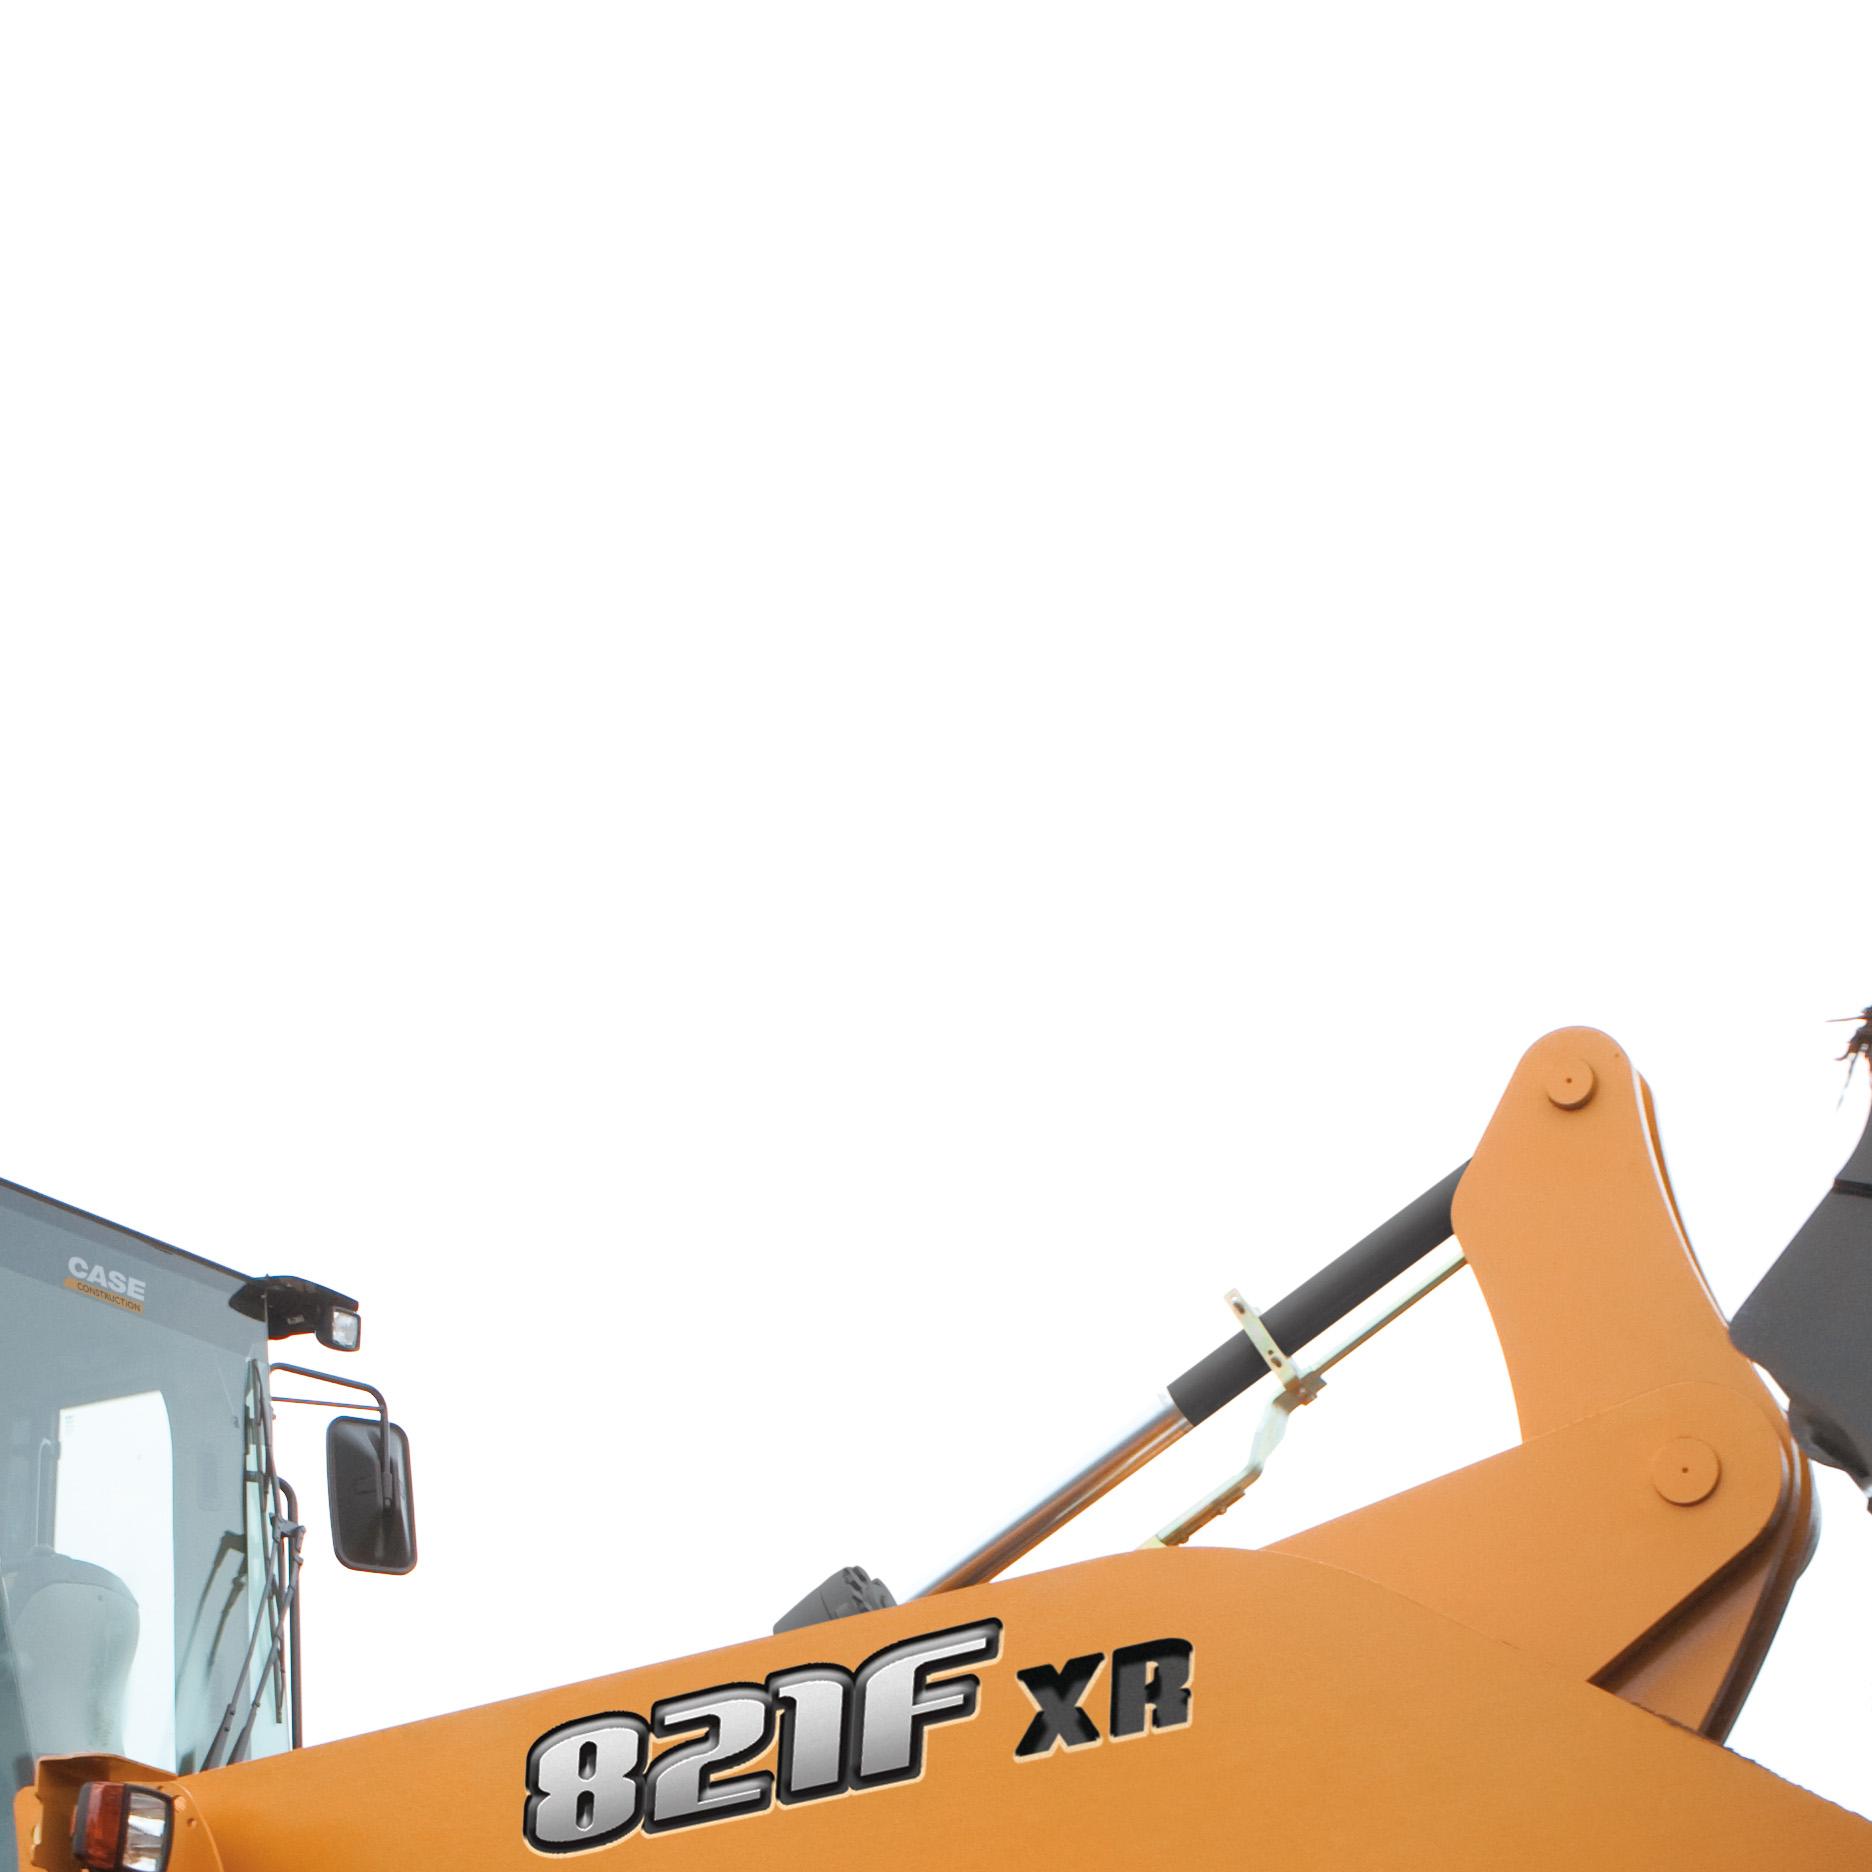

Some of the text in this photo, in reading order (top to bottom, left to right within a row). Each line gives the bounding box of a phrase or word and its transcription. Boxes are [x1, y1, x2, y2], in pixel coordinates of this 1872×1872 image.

[68, 1256, 146, 1301] CASE
[76, 1282, 142, 1313] CONSTRUCTION
[524, 1617, 1193, 1855] 821F XR
